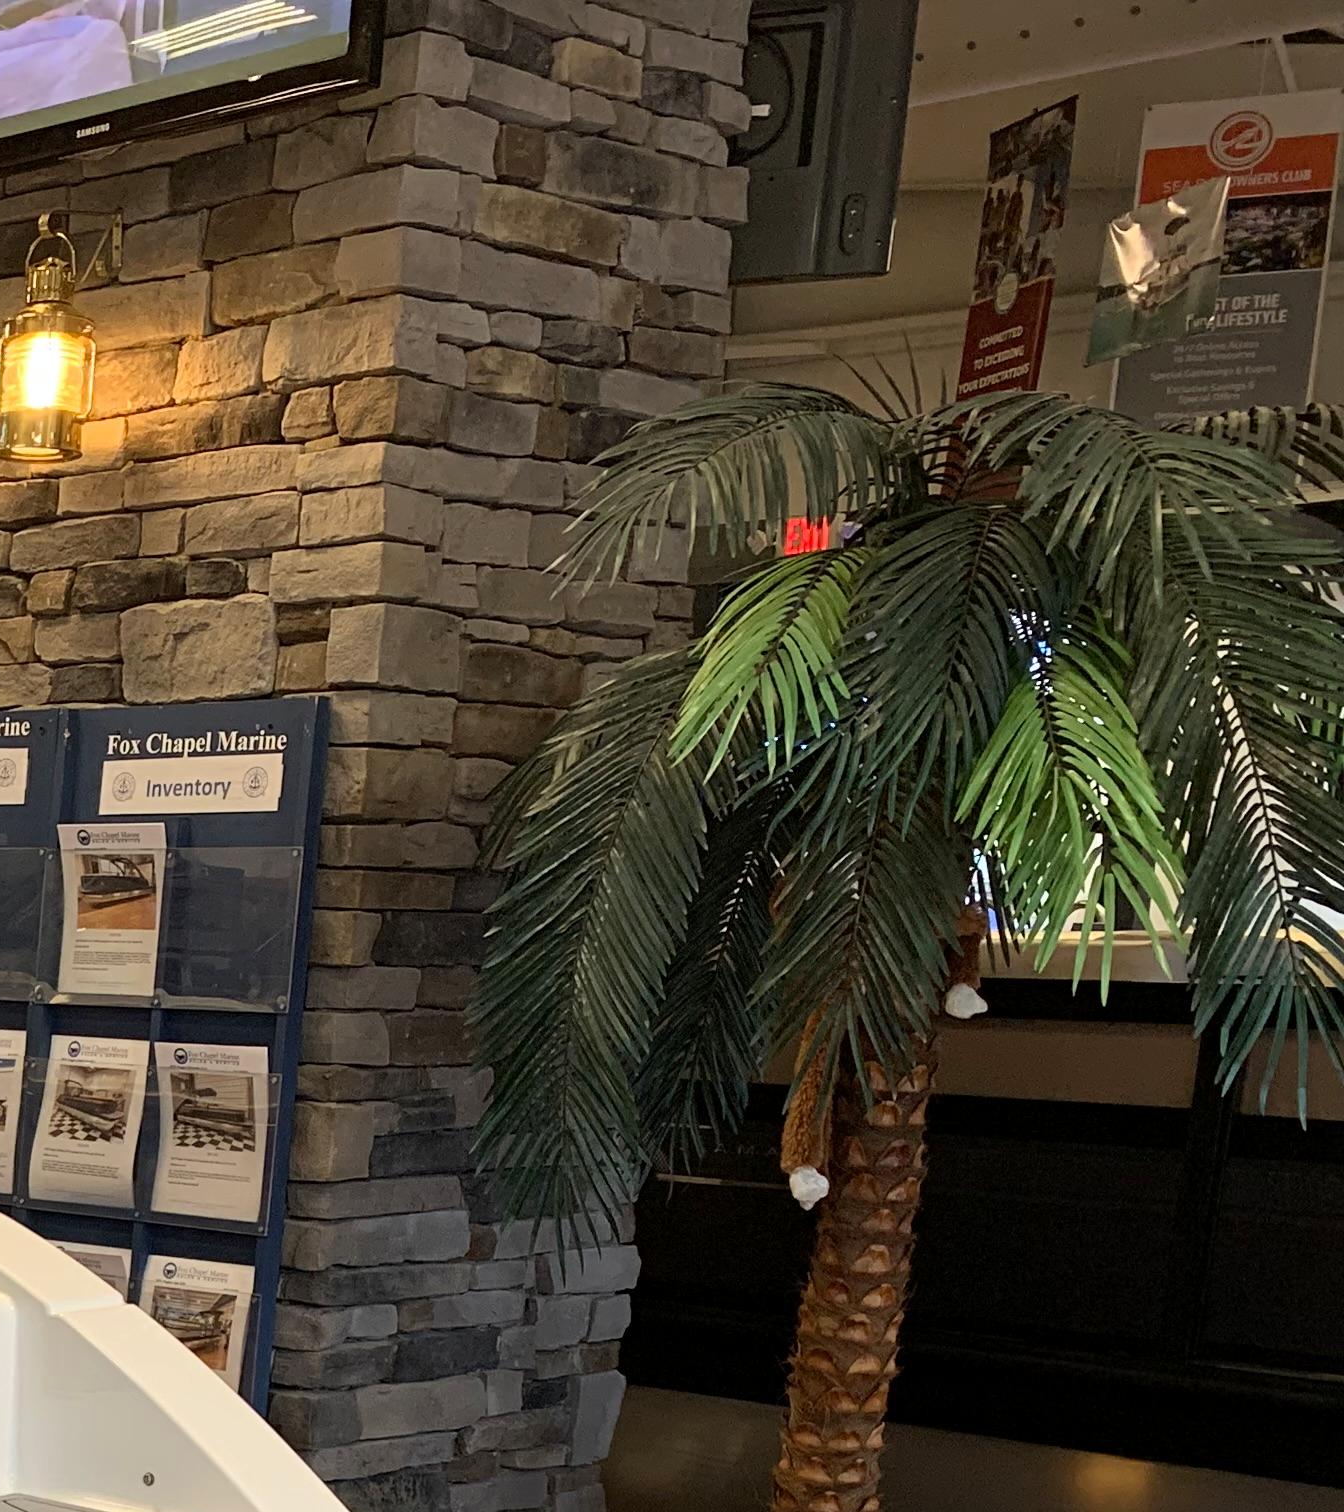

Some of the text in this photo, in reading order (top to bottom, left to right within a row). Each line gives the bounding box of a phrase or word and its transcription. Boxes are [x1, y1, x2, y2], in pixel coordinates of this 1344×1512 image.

[76, 122, 110, 138] SAMSUNG
[1230, 169, 1312, 188] OWNERS CLUB
[1231, 296, 1250, 310] OF
[1254, 293, 1281, 308] THE
[1216, 309, 1289, 328] LIFESTYLE
[959, 379, 978, 395] YOUR
[106, 730, 288, 758] Fox Chapel Marine
[146, 779, 232, 800] Inventory
